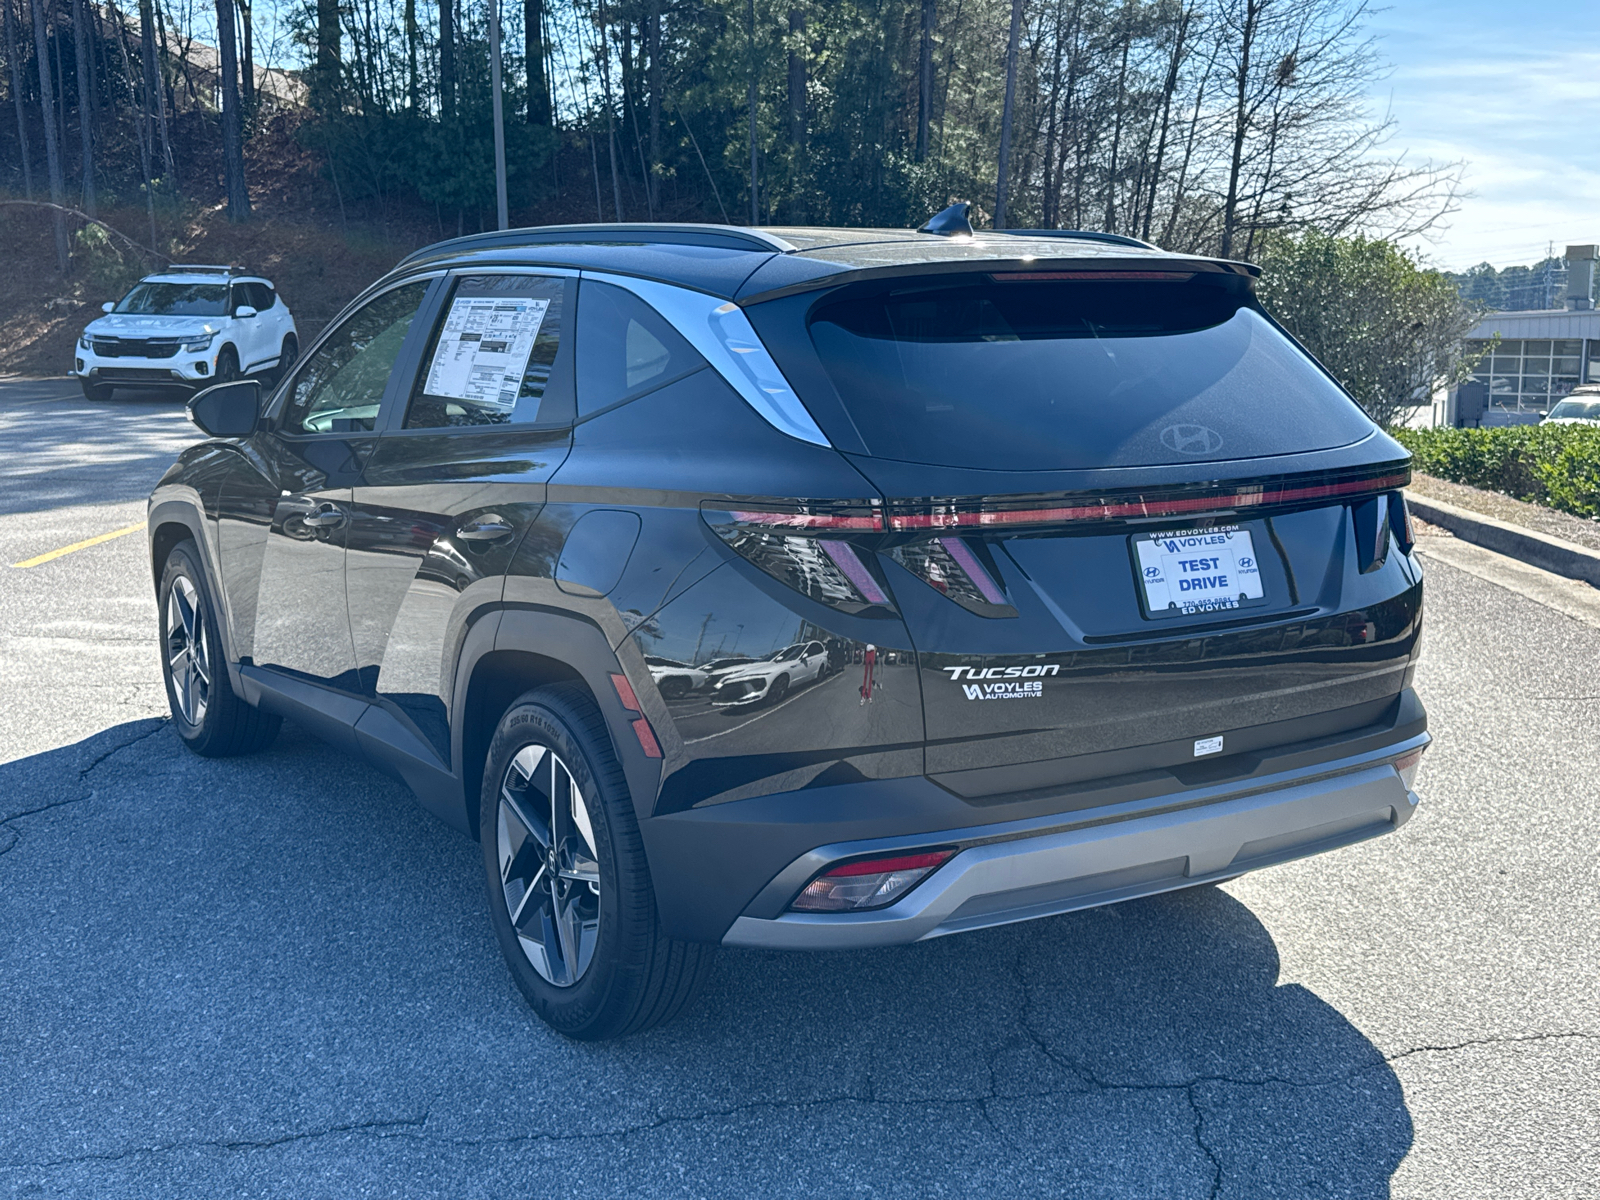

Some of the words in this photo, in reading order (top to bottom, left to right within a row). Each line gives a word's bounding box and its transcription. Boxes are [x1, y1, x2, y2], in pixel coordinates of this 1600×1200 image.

[1149, 525, 1239, 539] WWW.EDVOYLES.COM
[1178, 535, 1226, 548] VOYLES
[1178, 558, 1219, 572] TEST
[1179, 575, 1228, 591] DRIVE
[1181, 606, 1196, 615] ED
[1198, 601, 1240, 613] VOYLES
[983, 681, 1043, 693] VOYLES
[984, 690, 1043, 700] AUTOMOTIVE
